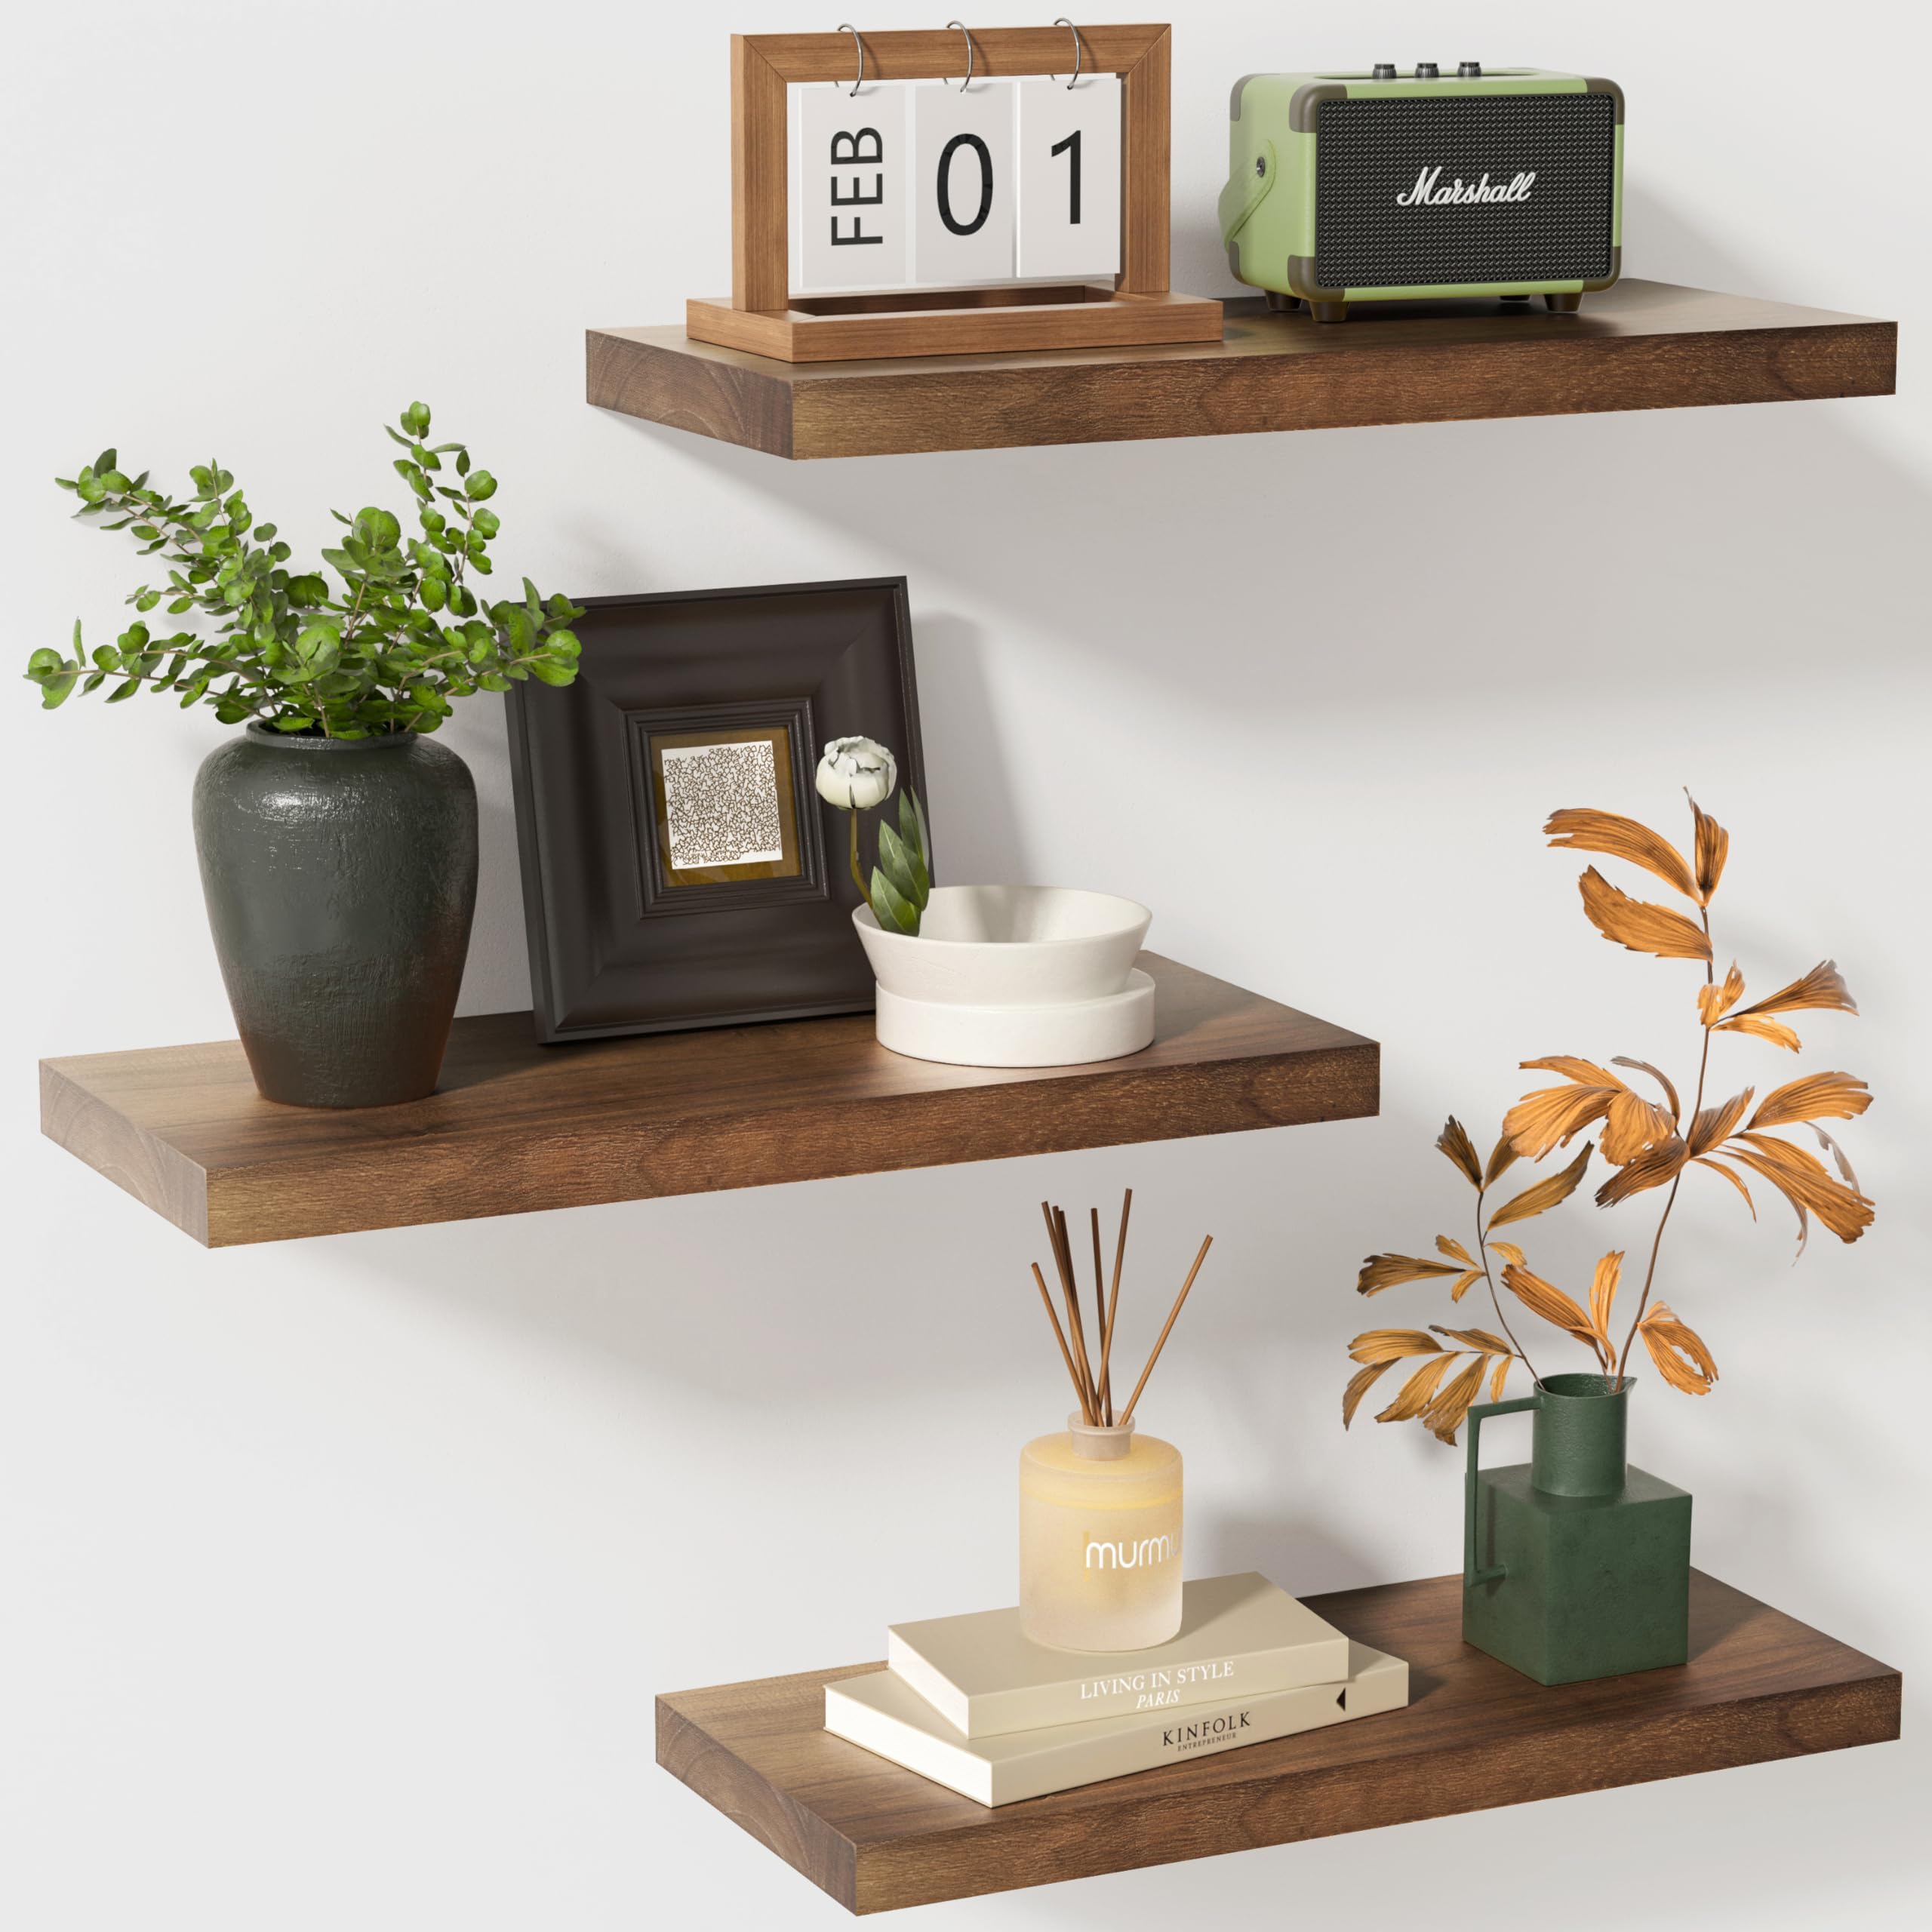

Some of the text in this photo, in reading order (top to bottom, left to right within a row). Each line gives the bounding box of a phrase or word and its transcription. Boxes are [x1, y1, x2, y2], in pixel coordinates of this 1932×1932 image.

[830, 126, 883, 246] FEB
[1396, 165, 1537, 206] Marshall
[1080, 1660, 1235, 1700] LIVING IN STYLE
[1136, 1688, 1181, 1709] PARIS
[1162, 1711, 1251, 1746] KINFOLK
[1177, 1732, 1237, 1752] ENTREPRENEUR
